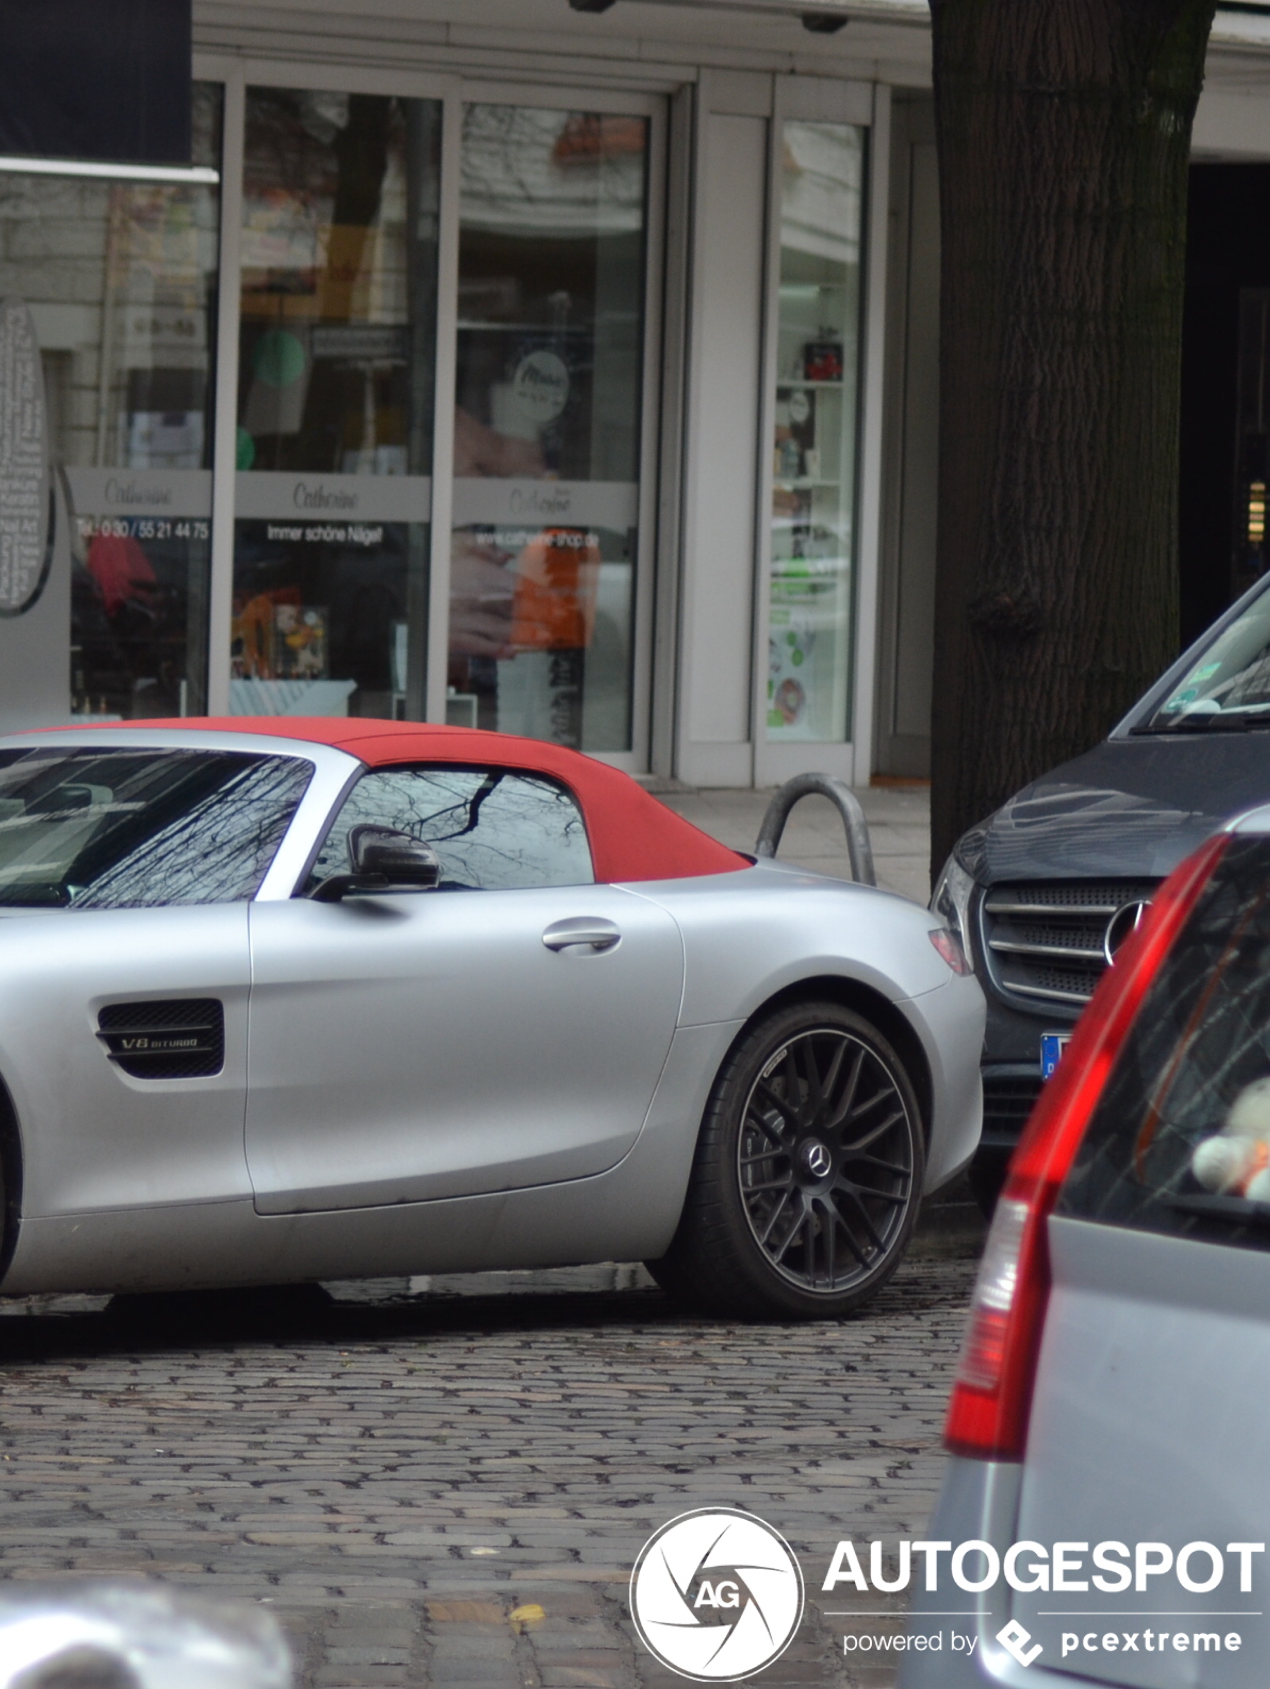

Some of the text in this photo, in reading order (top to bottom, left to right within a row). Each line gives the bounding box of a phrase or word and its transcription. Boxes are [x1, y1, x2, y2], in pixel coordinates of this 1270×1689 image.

[293, 482, 359, 509] Catherine
[139, 521, 154, 538] 55
[156, 522, 171, 538] 21
[174, 522, 190, 538] 44
[194, 522, 209, 539] 75
[267, 524, 303, 541] Immer
[305, 525, 346, 542] schöne
[121, 1038, 198, 1049] V8 BITURBO
